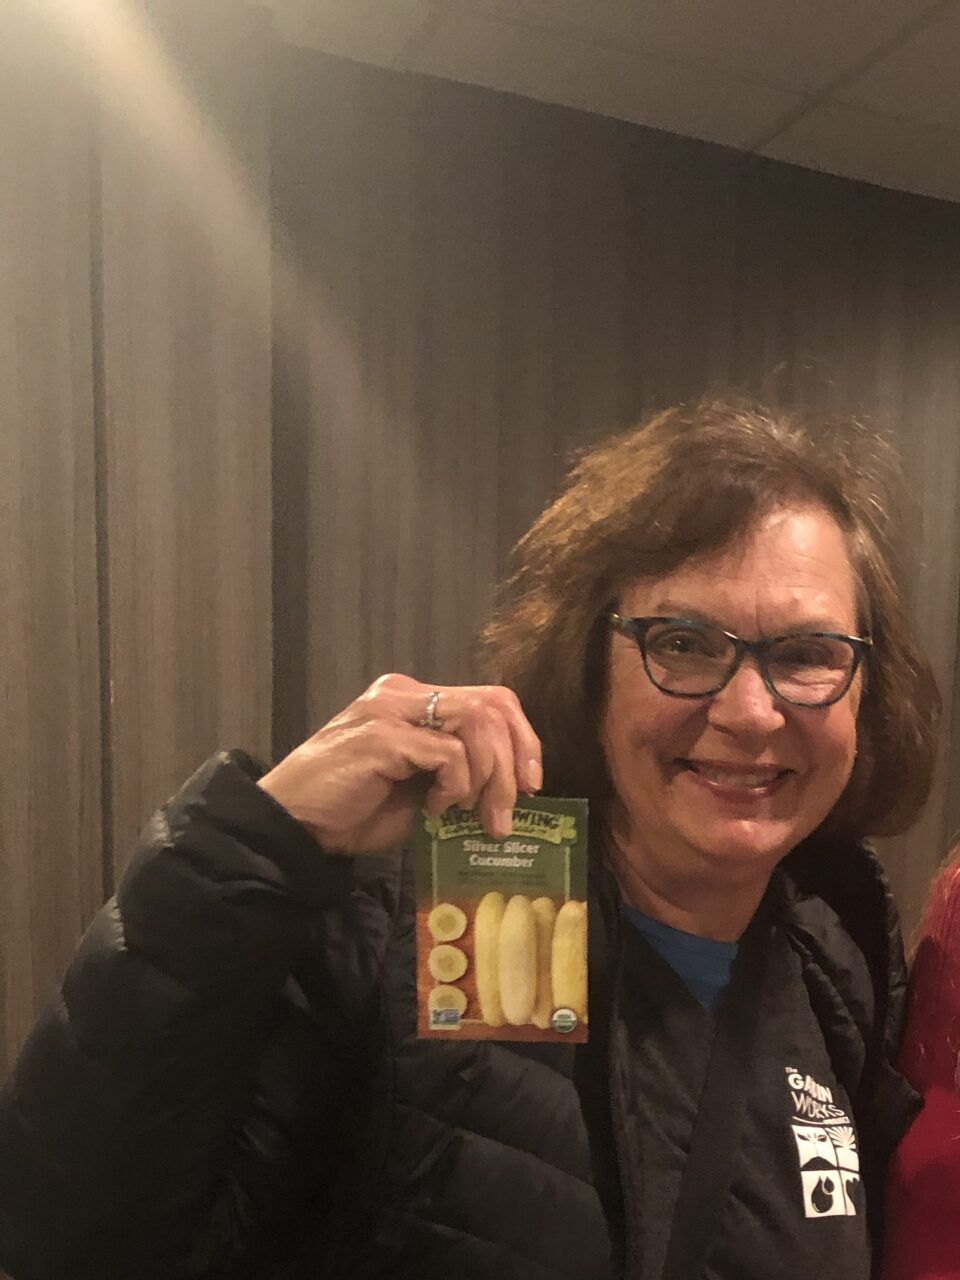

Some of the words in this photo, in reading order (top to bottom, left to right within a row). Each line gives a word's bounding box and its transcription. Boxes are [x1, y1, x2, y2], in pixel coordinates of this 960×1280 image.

[462, 839, 500, 853] Silver
[503, 840, 541, 854] Slicer
[468, 853, 535, 868] Cucumber
